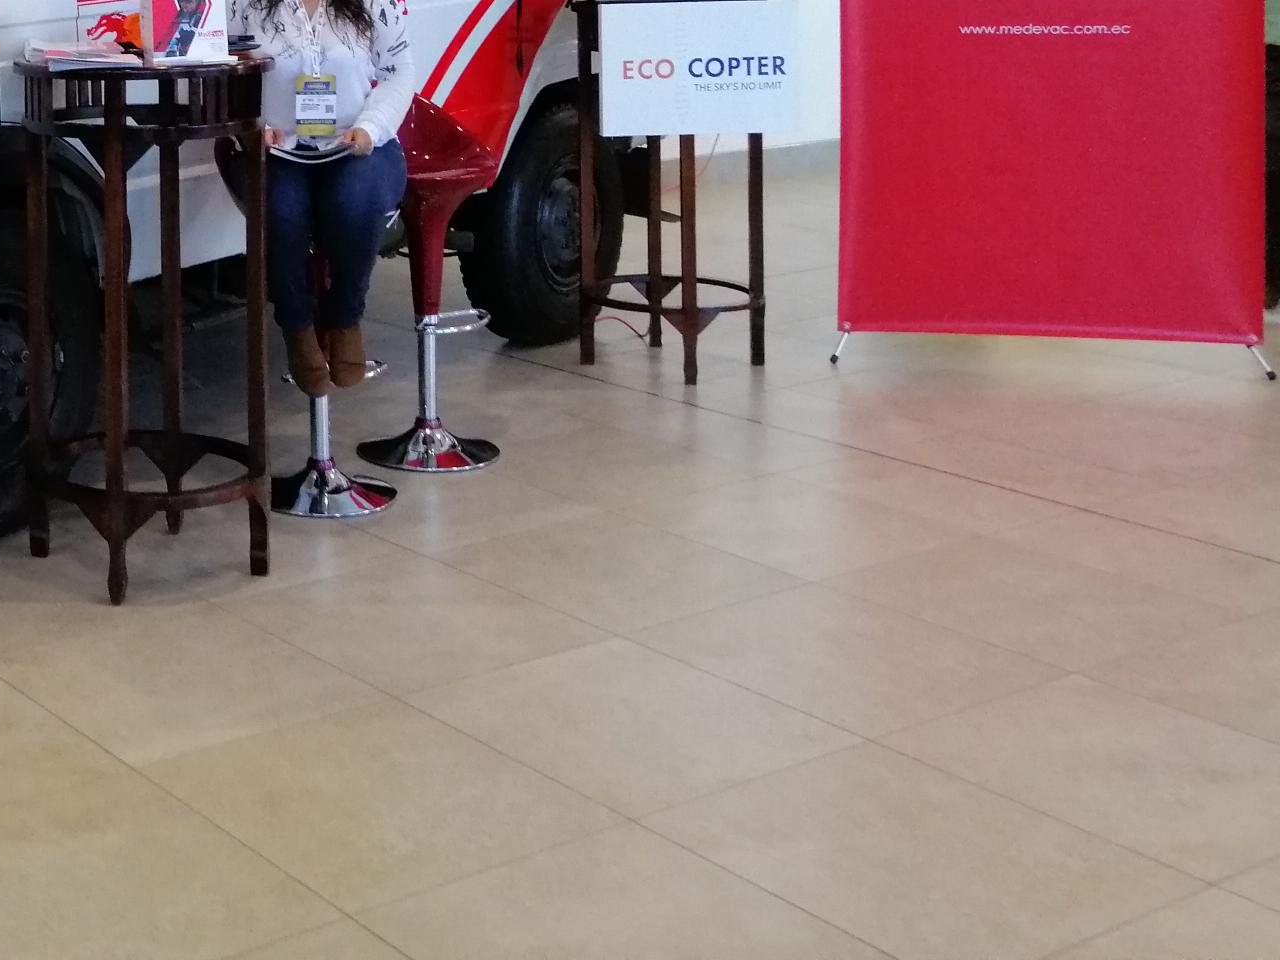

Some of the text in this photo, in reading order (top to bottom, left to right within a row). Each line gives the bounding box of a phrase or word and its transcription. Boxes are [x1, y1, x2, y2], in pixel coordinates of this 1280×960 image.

[959, 22, 1131, 35] www.medevac.com.ec
[623, 56, 786, 80] ECO COPTER
[694, 81, 783, 91] THE SKY'S NO LIMIT
